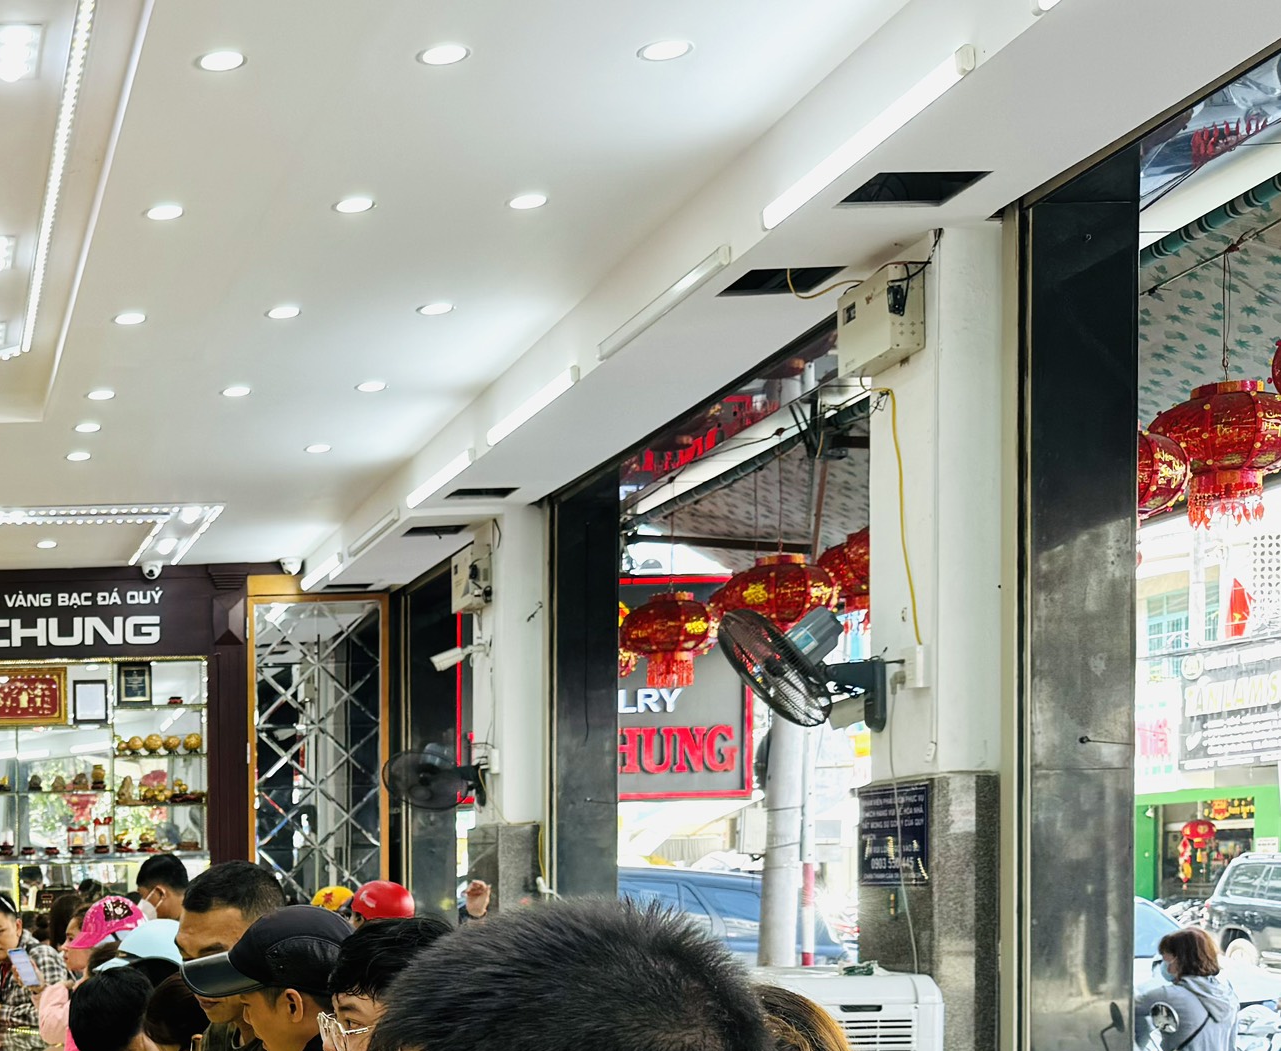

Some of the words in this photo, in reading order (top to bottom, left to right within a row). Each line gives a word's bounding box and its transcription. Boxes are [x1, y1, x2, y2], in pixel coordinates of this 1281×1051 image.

[4, 591, 52, 608] VÀNG
[57, 592, 92, 610] BẠC
[96, 588, 122, 606] ĐÁ
[126, 587, 163, 605] QUÝ
[618, 688, 684, 713] LRY
[618, 725, 738, 774] HUNG
